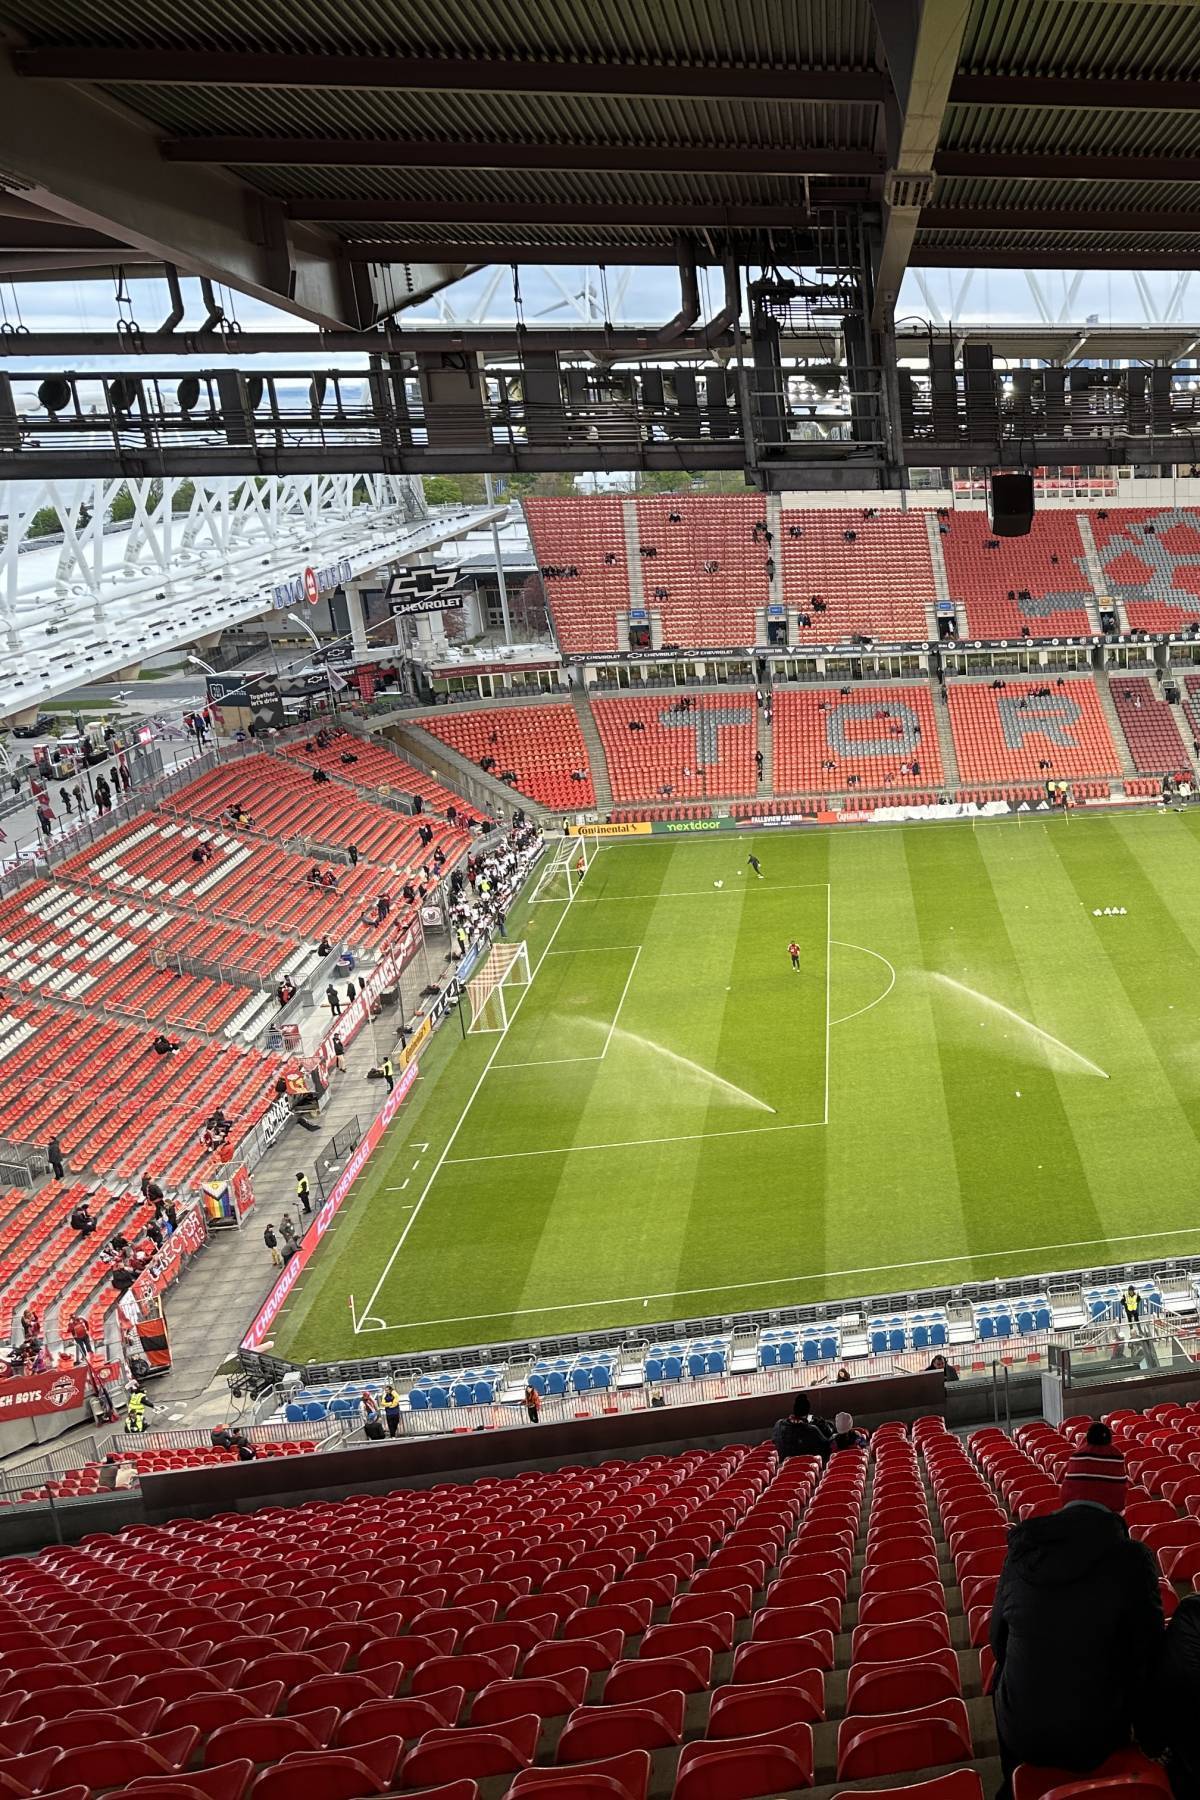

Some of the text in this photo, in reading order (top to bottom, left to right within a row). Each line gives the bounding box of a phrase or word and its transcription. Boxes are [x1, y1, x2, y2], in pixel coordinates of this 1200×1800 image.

[273, 562, 352, 610] BMO FIELD
[393, 598, 462, 614] CHEVROLET
[250, 691, 276, 700] Together
[578, 825, 630, 835] Continental
[666, 821, 720, 831] nextdoor
[335, 1141, 370, 1202] CHEVROLET
[191, 1226, 206, 1248] 113
[256, 1256, 300, 1338] CHEVROLET
[15, 1390, 42, 1405] BOYS
